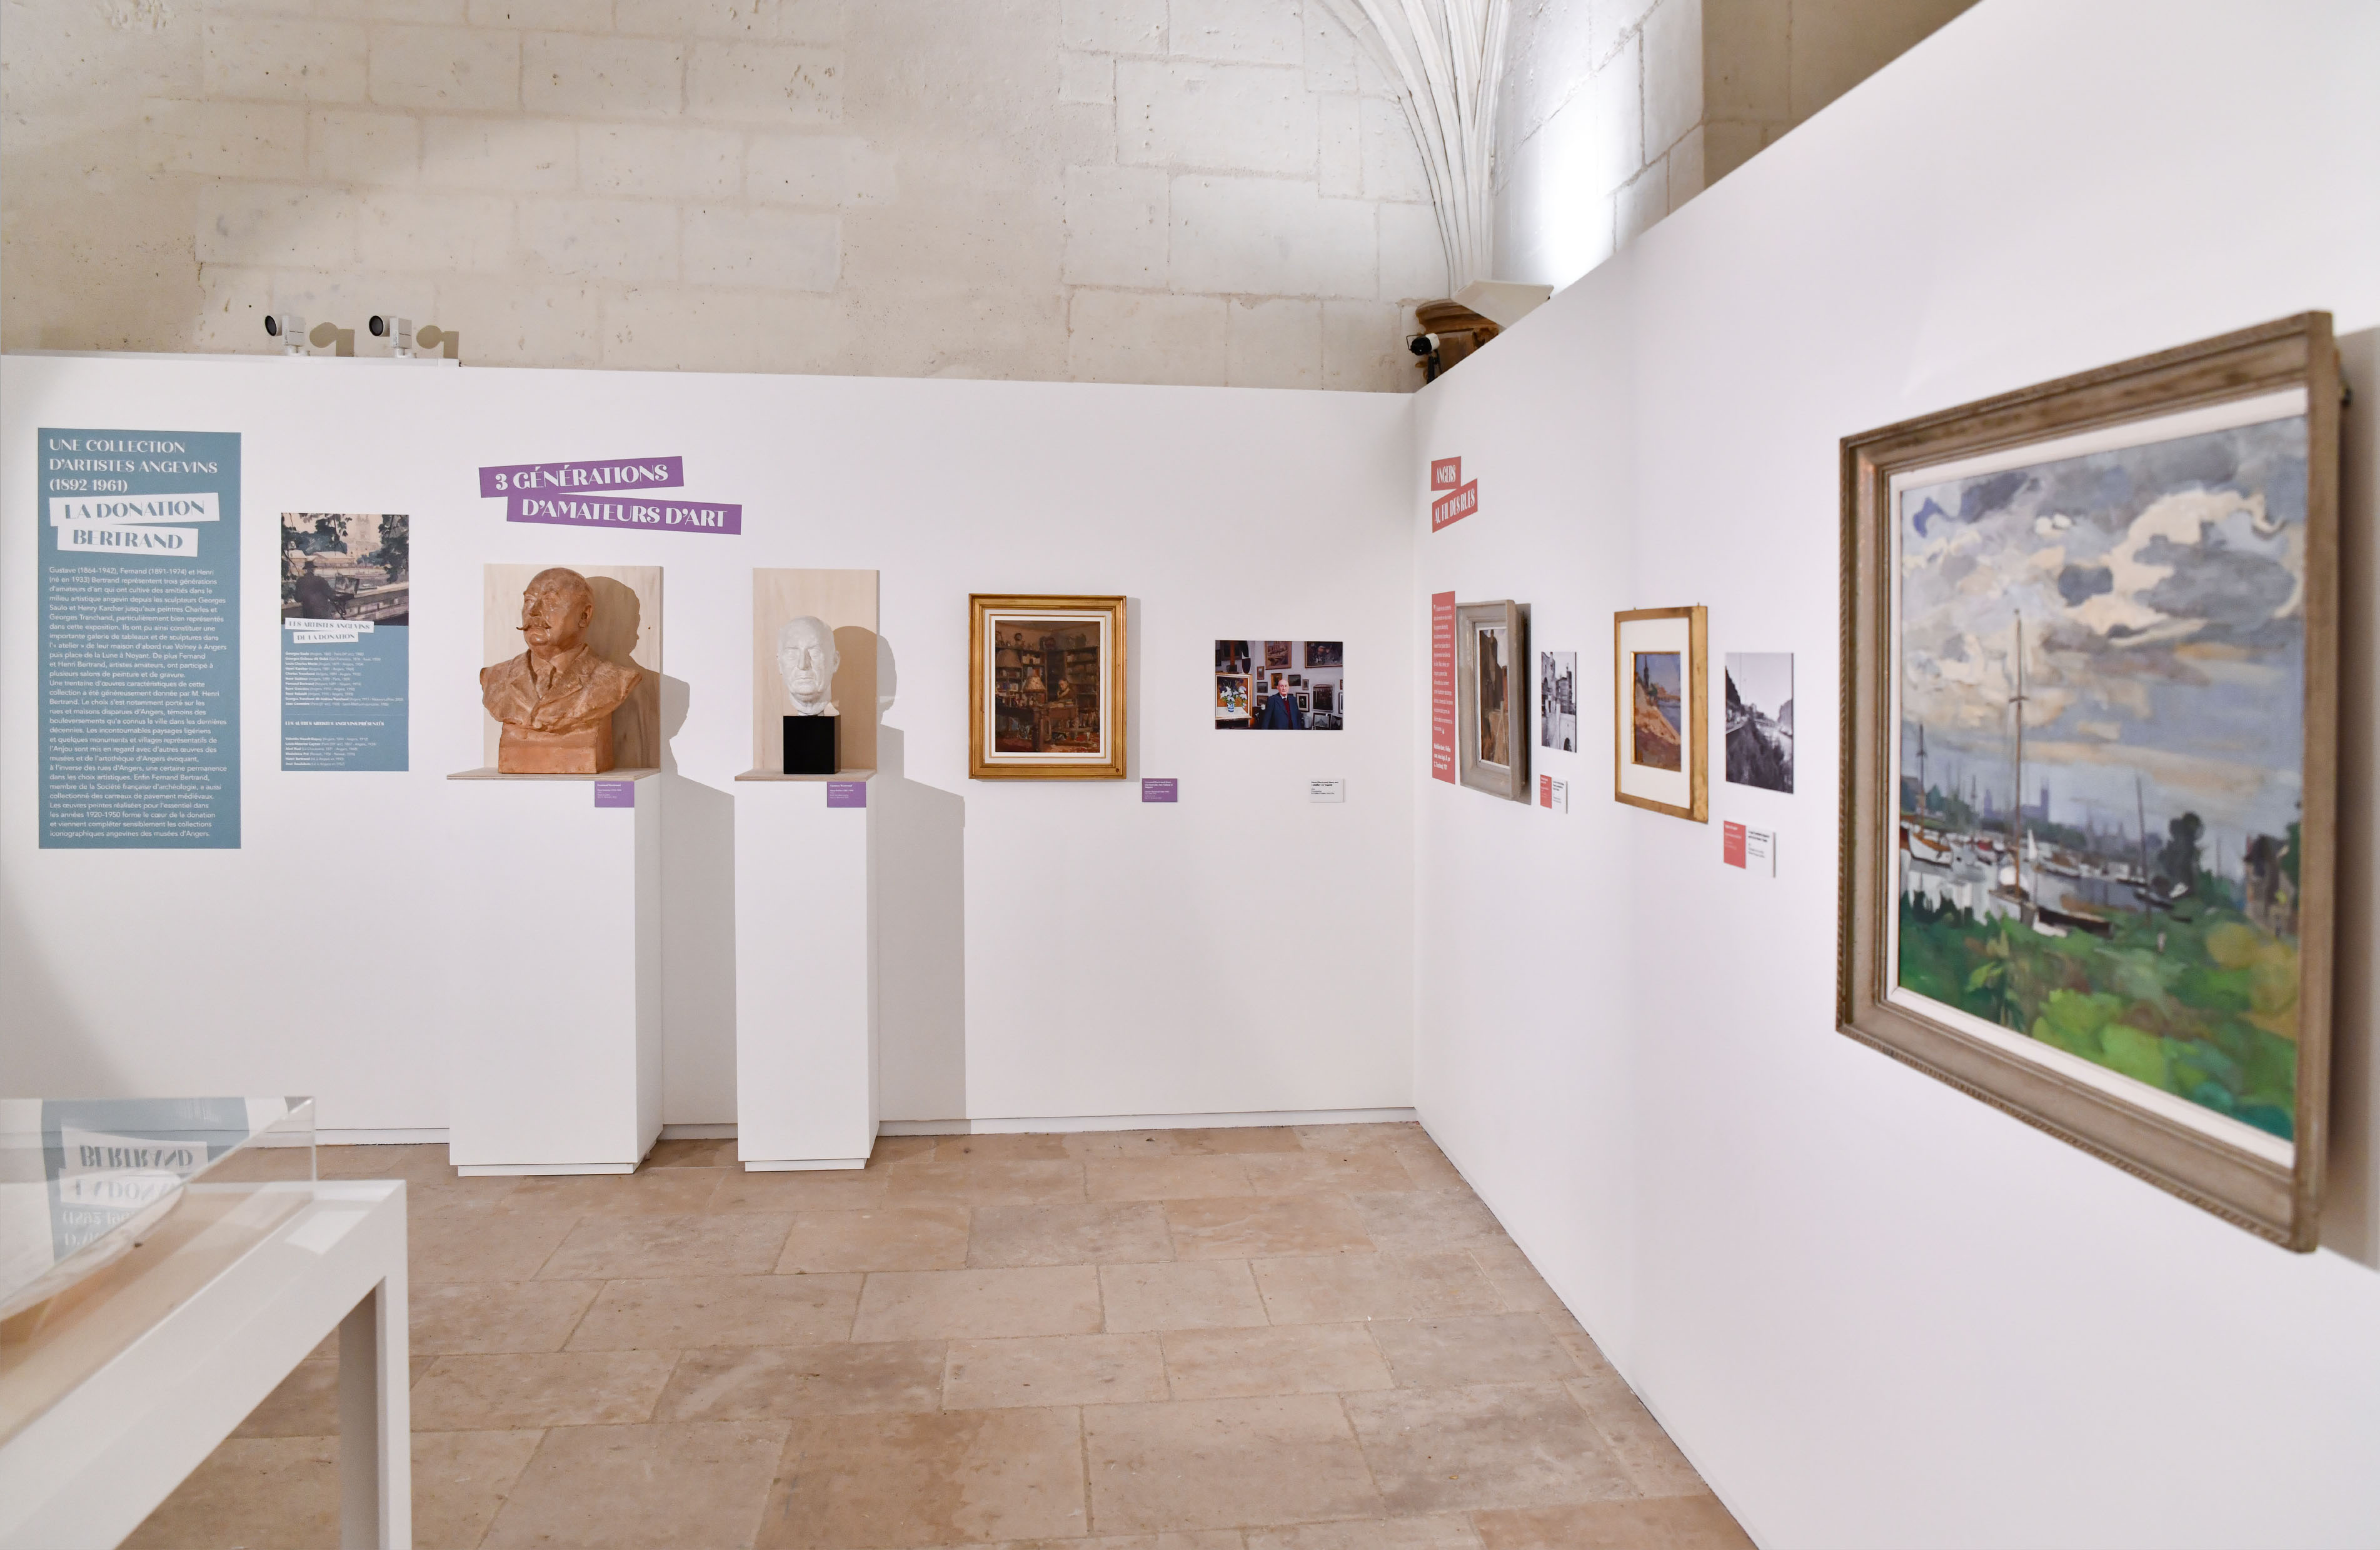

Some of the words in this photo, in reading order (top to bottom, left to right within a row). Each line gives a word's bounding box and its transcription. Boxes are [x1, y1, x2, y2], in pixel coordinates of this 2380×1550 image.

[49, 439, 81, 451] UNE
[86, 439, 185, 453] COLLECTION
[49, 458, 134, 472] D'ARTISTES
[139, 461, 218, 474] ANGEVINS
[1436, 464, 1456, 484] ANGERS
[495, 473, 508, 491] 3
[513, 464, 668, 489] GÉNÉRATIONS
[65, 504, 91, 519] LA
[96, 500, 204, 518] DONATION
[522, 499, 661, 524] D'AMATEURS
[665, 508, 728, 528] D'ART
[73, 529, 183, 549] BERTRAND
[179, 578, 218, 586] générations
